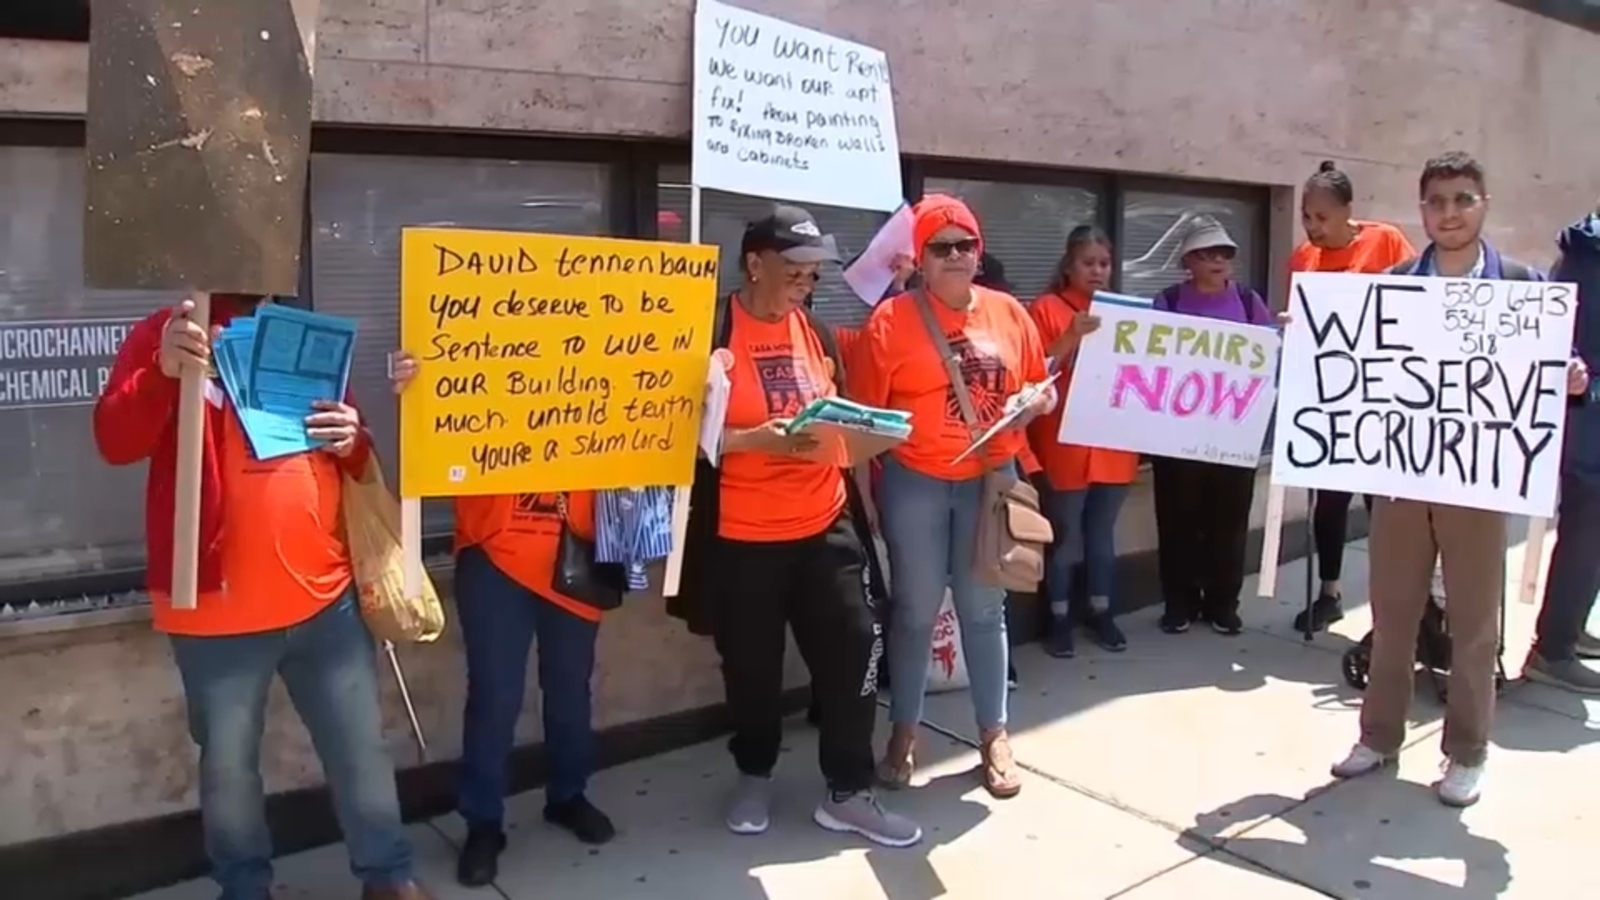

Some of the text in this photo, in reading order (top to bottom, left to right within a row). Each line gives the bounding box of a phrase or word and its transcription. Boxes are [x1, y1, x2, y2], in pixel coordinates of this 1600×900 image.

[708, 56, 738, 80] We
[845, 84, 879, 103] apt
[433, 243, 538, 276] DAVID
[640, 290, 675, 314] be
[1296, 282, 1426, 352] WE
[1442, 282, 1571, 317] 530 643
[1442, 309, 1541, 340] 534 514
[1112, 320, 1266, 369] REPAIRS
[1459, 333, 1498, 355] 518
[436, 372, 488, 398] OUR
[1110, 364, 1269, 425] NOW
[1314, 349, 1567, 430] DESERVE
[527, 398, 608, 431] untold
[1287, 406, 1554, 500] SECRURITY
